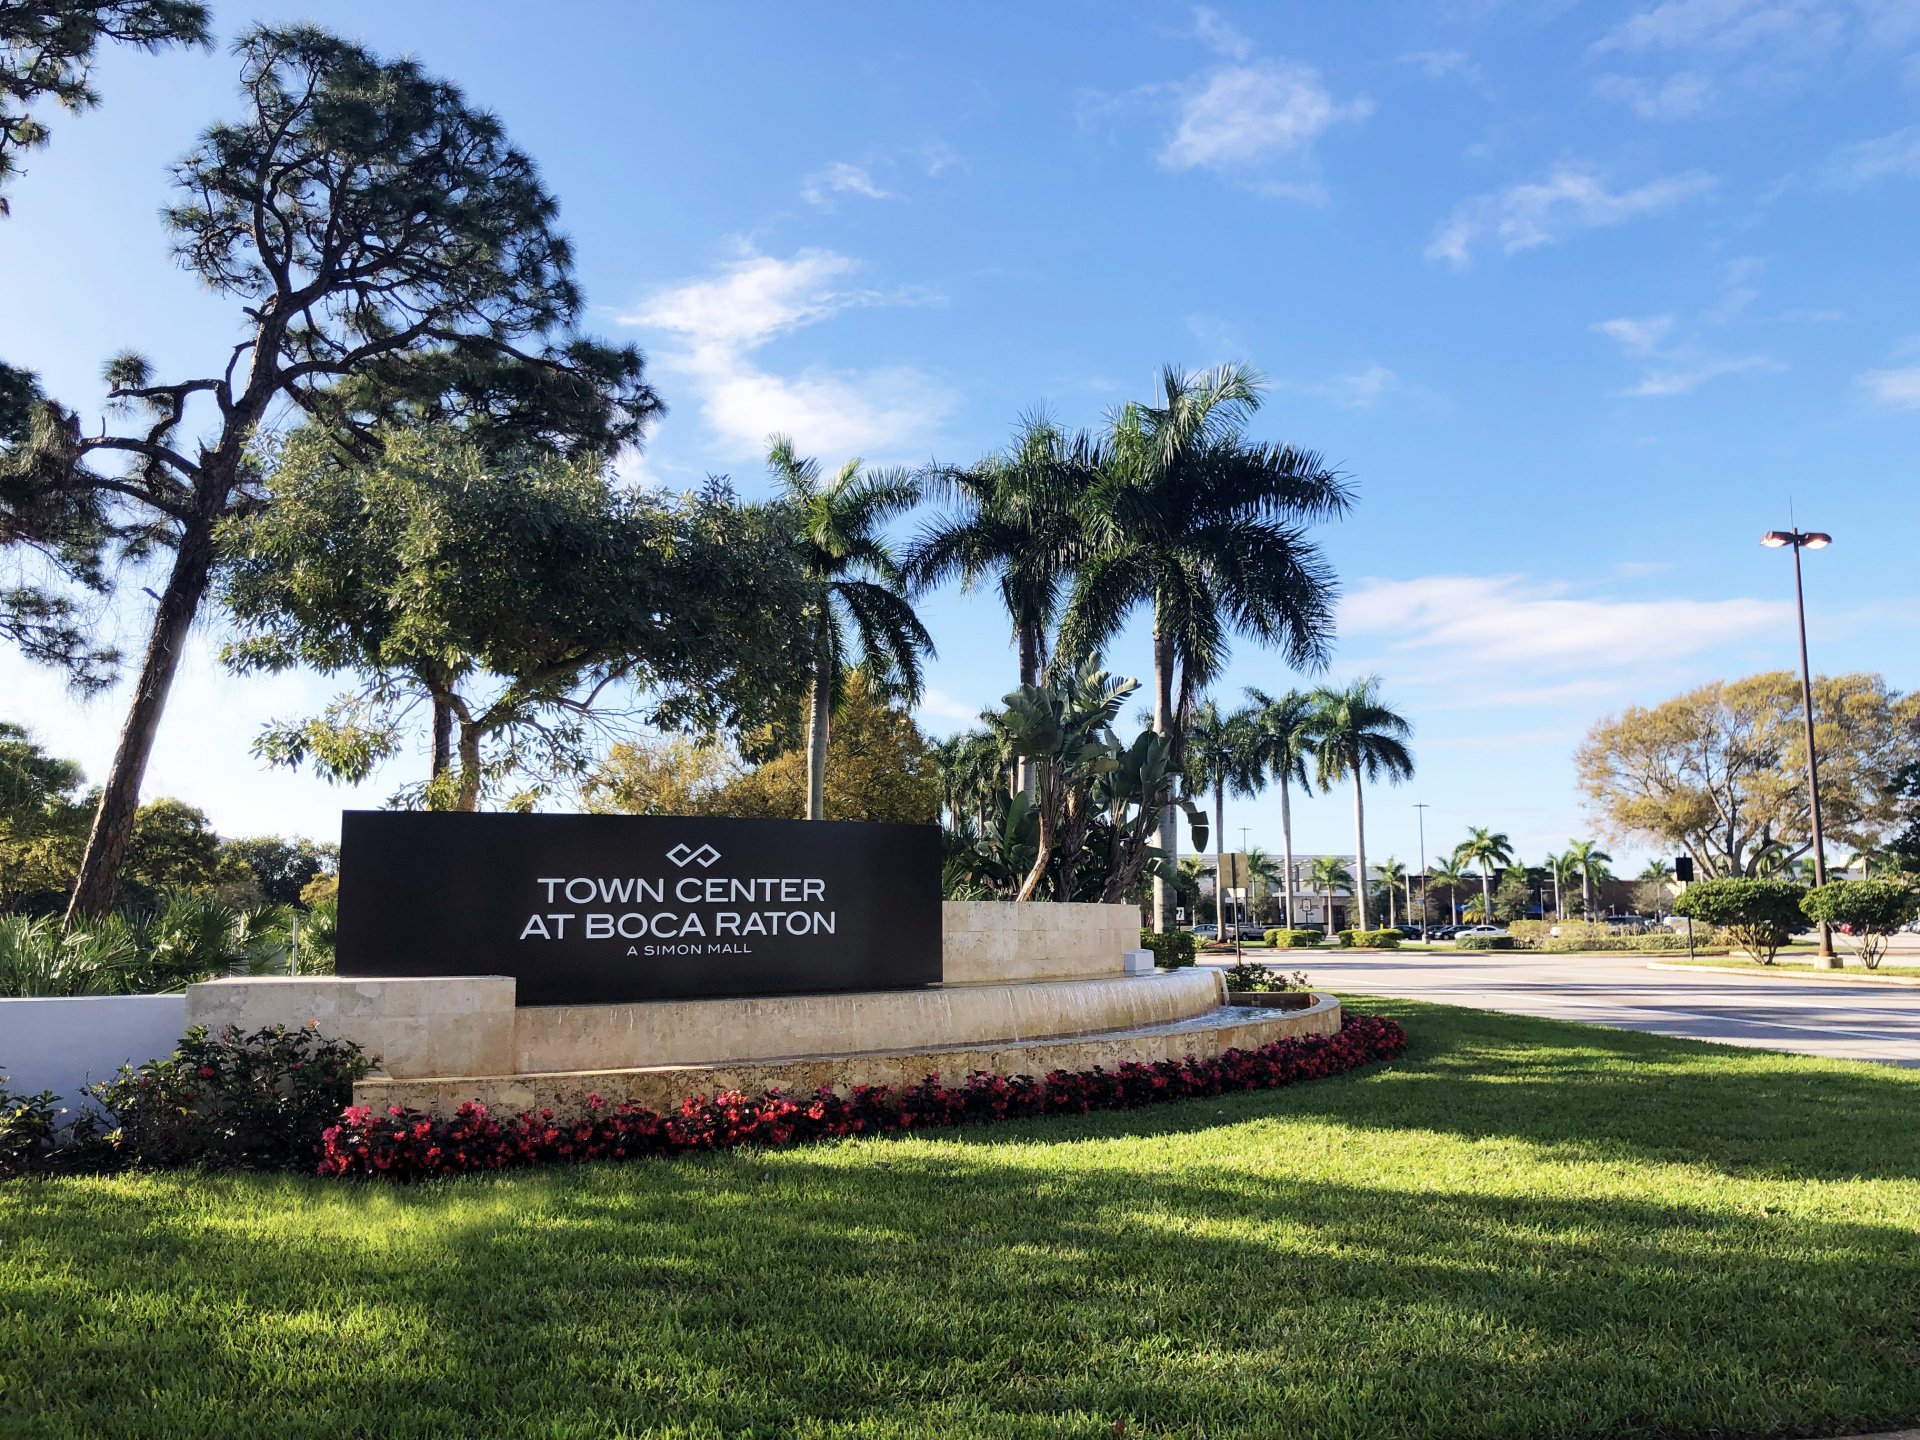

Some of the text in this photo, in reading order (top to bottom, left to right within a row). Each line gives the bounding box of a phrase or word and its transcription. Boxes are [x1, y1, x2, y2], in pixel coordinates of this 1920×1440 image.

[537, 878, 826, 903] TOWN CENTER
[519, 911, 836, 940] AT BOCA RATON
[626, 943, 752, 957] A SIMON MALL
